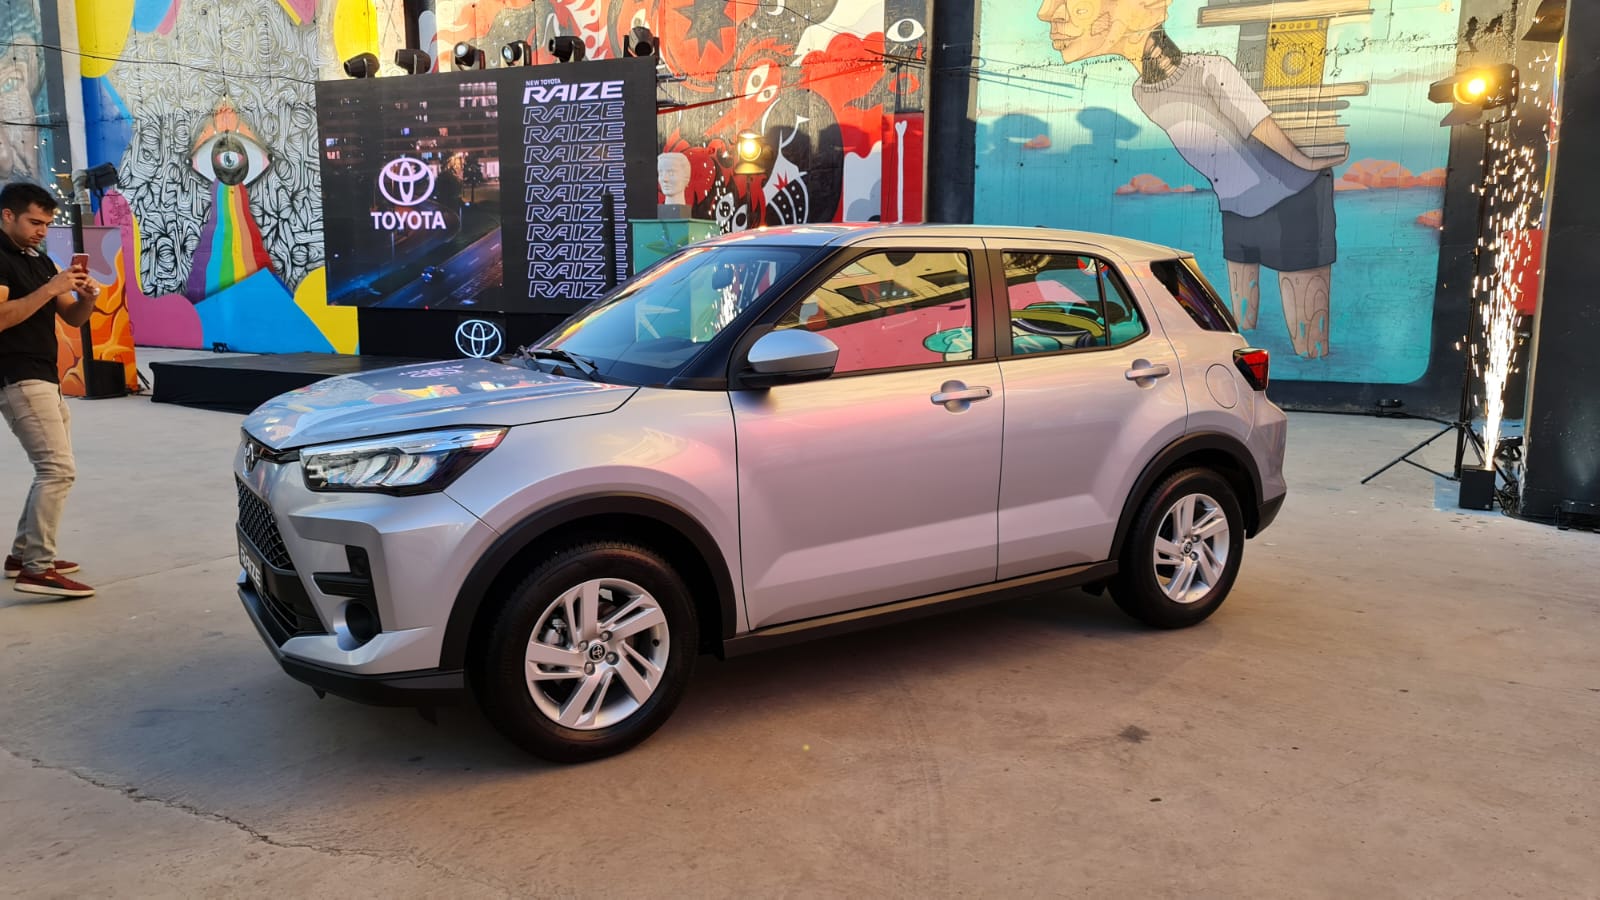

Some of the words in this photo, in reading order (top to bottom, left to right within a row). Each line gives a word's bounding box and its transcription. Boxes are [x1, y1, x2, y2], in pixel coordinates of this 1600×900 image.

[522, 80, 625, 104] RAIZE
[522, 101, 625, 125] RAIZE
[523, 121, 626, 144] RAIZE
[524, 142, 626, 164] RAIZE
[524, 162, 627, 184] RAIZE
[370, 210, 447, 230] TOYOTA
[528, 281, 607, 299] RAIZ
[240, 547, 261, 588] RAIZE
